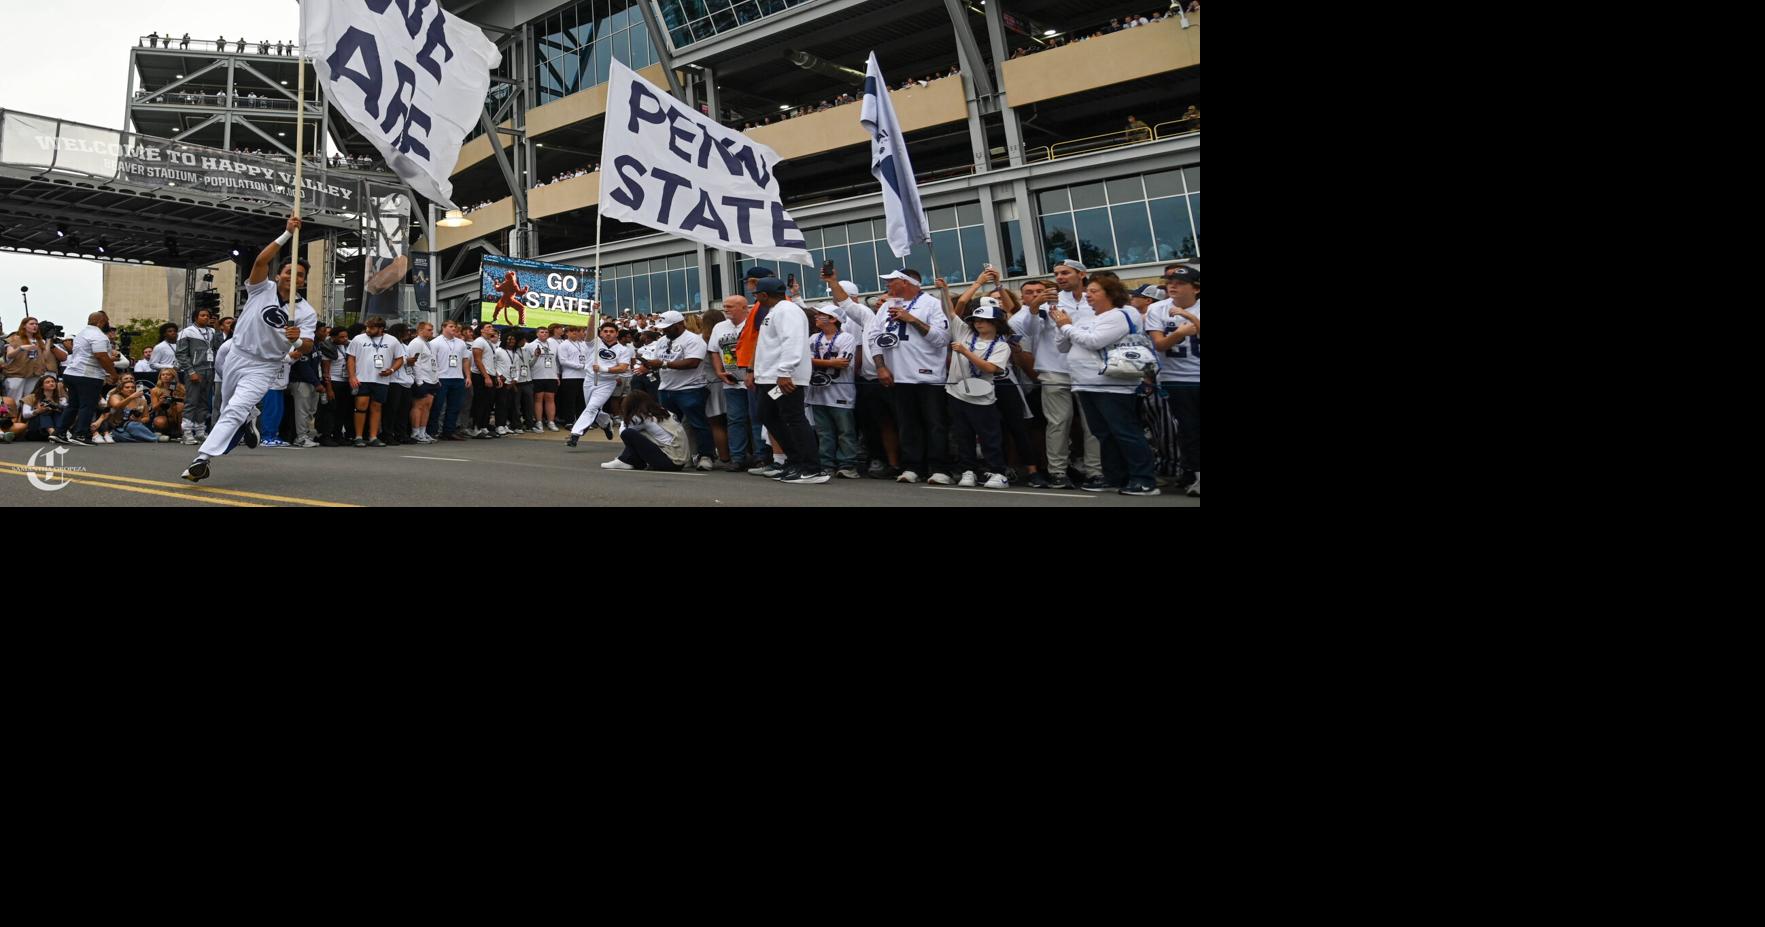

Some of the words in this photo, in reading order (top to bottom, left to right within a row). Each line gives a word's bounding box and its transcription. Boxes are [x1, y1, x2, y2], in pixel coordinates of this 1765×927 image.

[35, 135, 161, 162] WELCOME
[166, 149, 196, 166] TO
[201, 156, 275, 181] HAPPY
[278, 171, 353, 200] VALLEY
[628, 80, 771, 190] PENN
[104, 158, 145, 176] BEAVER
[147, 167, 197, 183] STADIUM
[204, 175, 268, 192] POPULATION
[609, 155, 807, 250] STATE
[547, 272, 578, 293] GO
